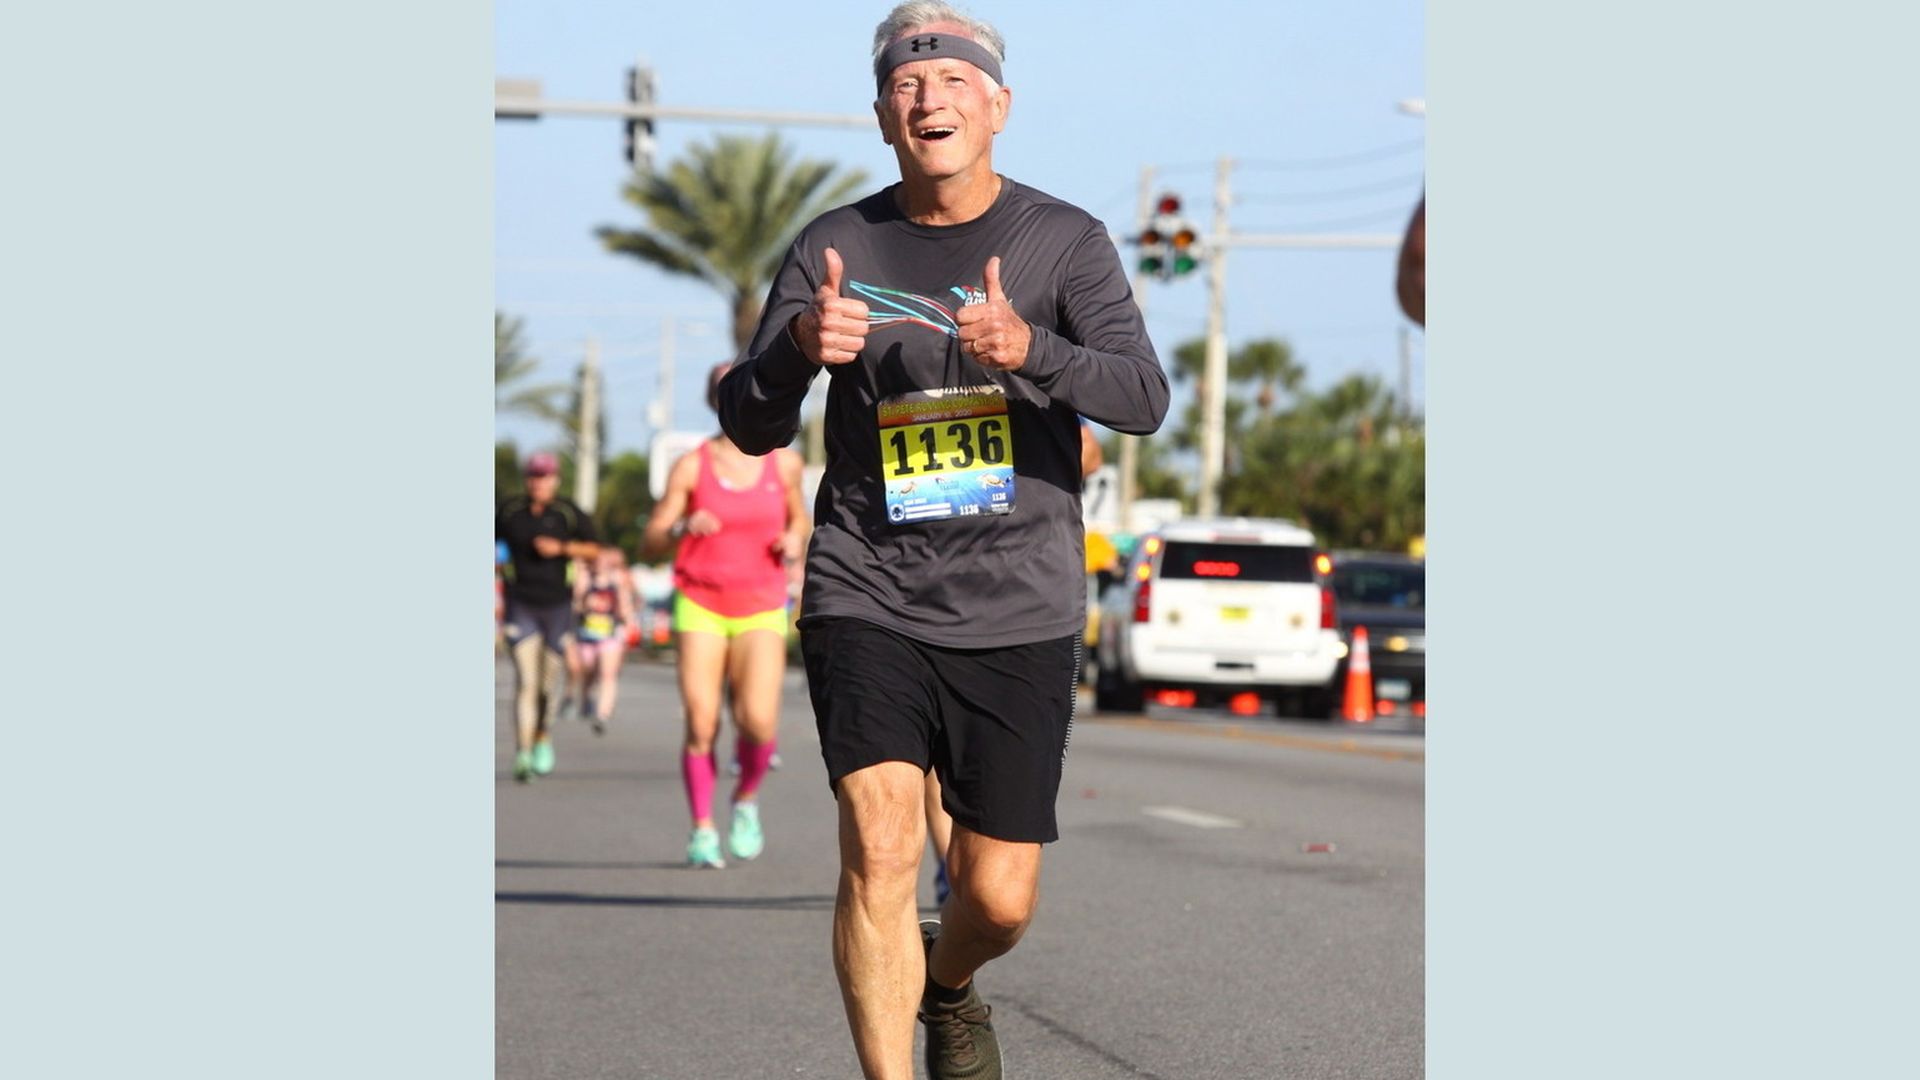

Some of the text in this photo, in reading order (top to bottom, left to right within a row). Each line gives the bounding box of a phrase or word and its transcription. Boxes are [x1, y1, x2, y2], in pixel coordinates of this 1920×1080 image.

[955, 407, 972, 417] 2020
[890, 419, 1004, 476] 1136
[992, 492, 1006, 501] 1136
[960, 503, 979, 515] 1136
